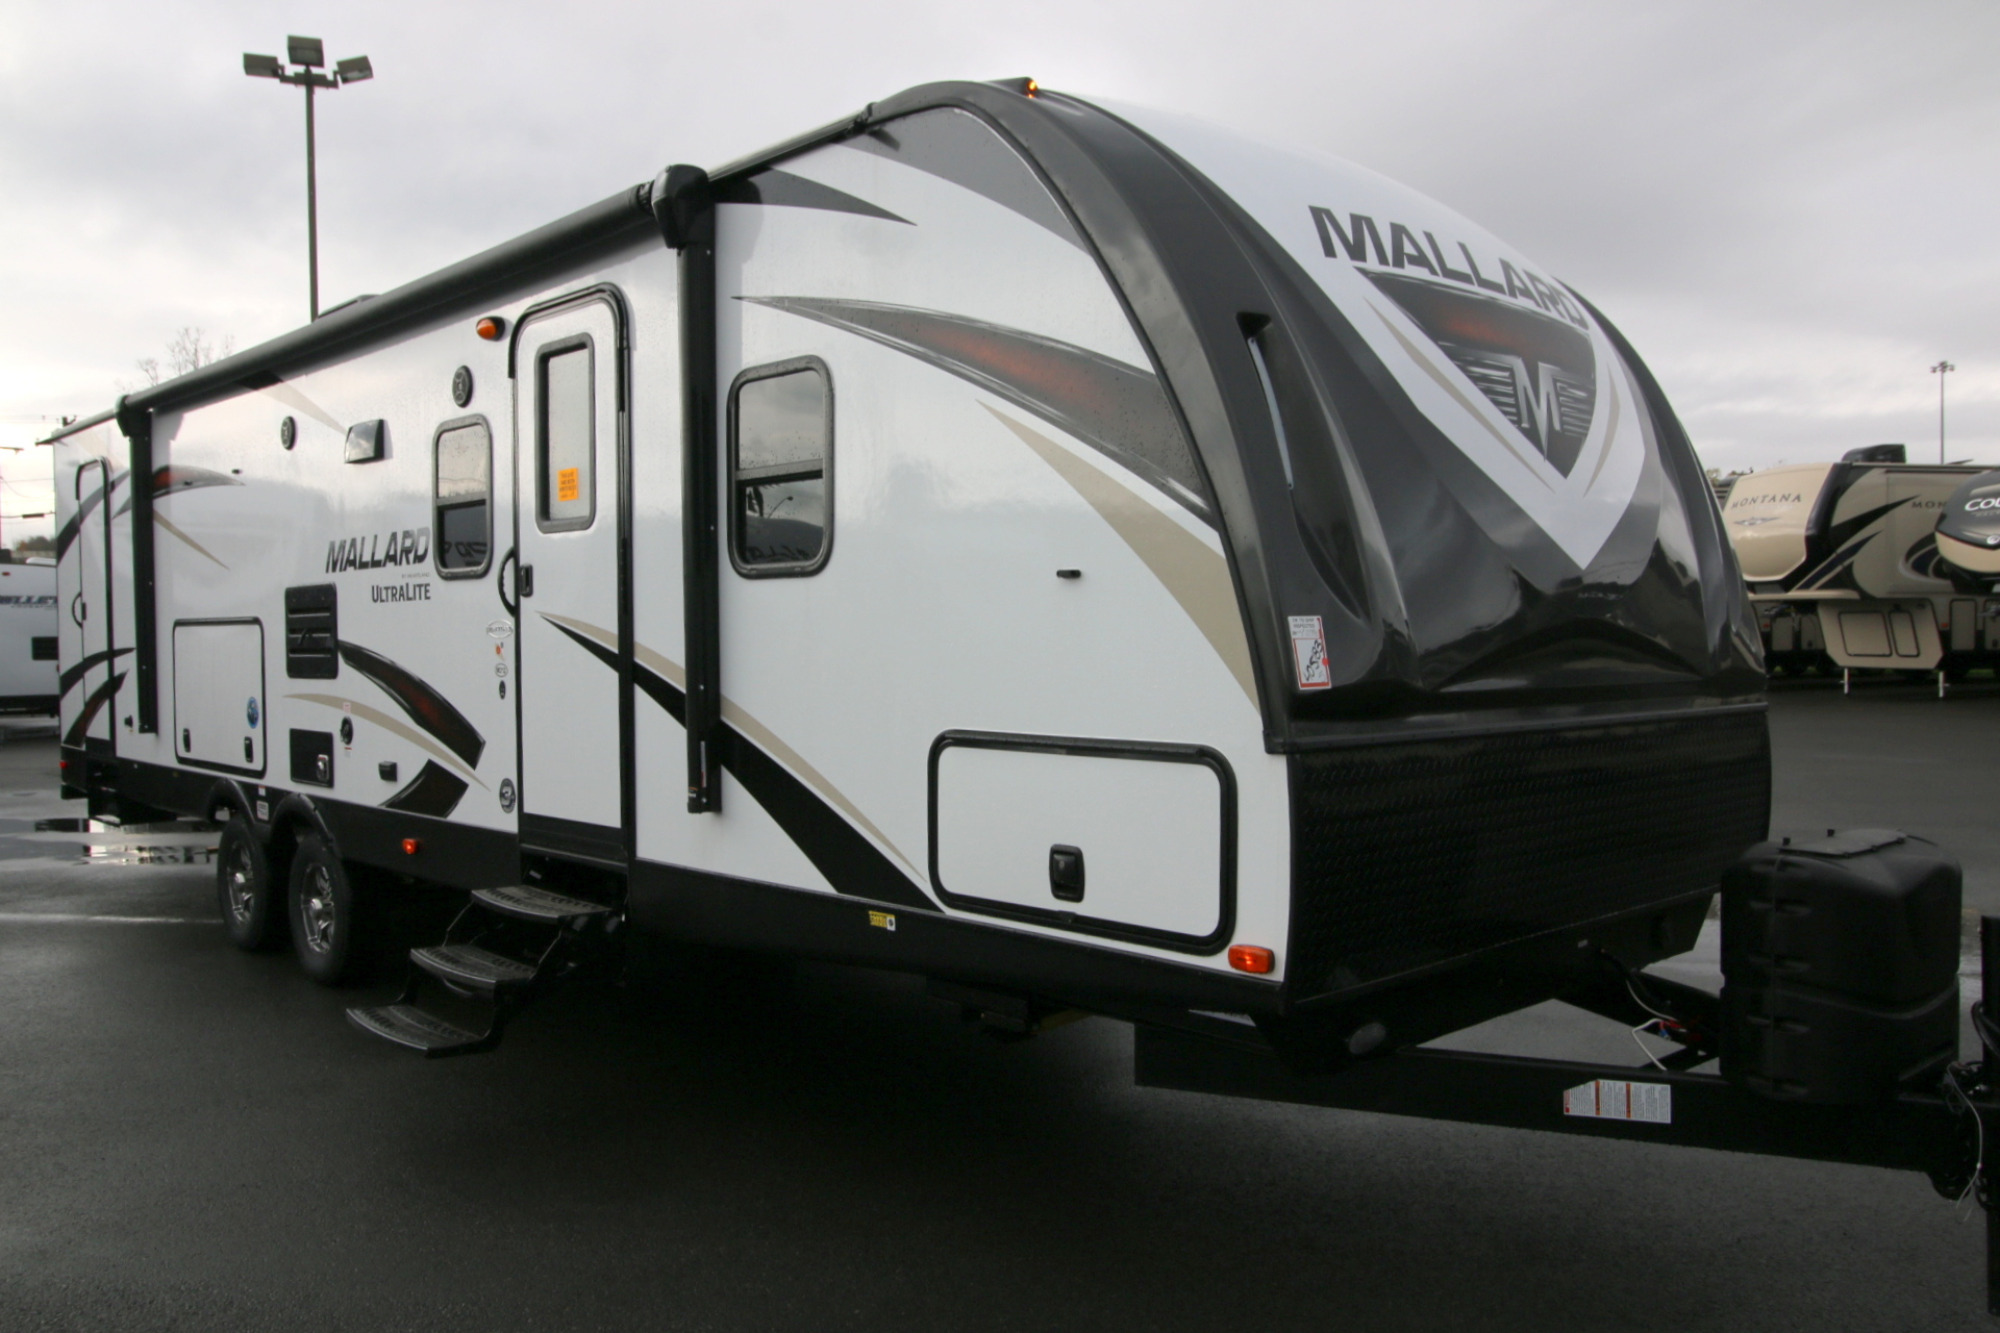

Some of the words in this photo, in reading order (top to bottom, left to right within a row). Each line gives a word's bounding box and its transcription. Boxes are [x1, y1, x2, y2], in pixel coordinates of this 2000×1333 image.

[1308, 205, 1590, 331] MALLARD
[1731, 493, 1803, 509] MONTANA
[325, 527, 431, 574] MALLARD
[371, 582, 431, 603] ULTRALITE
